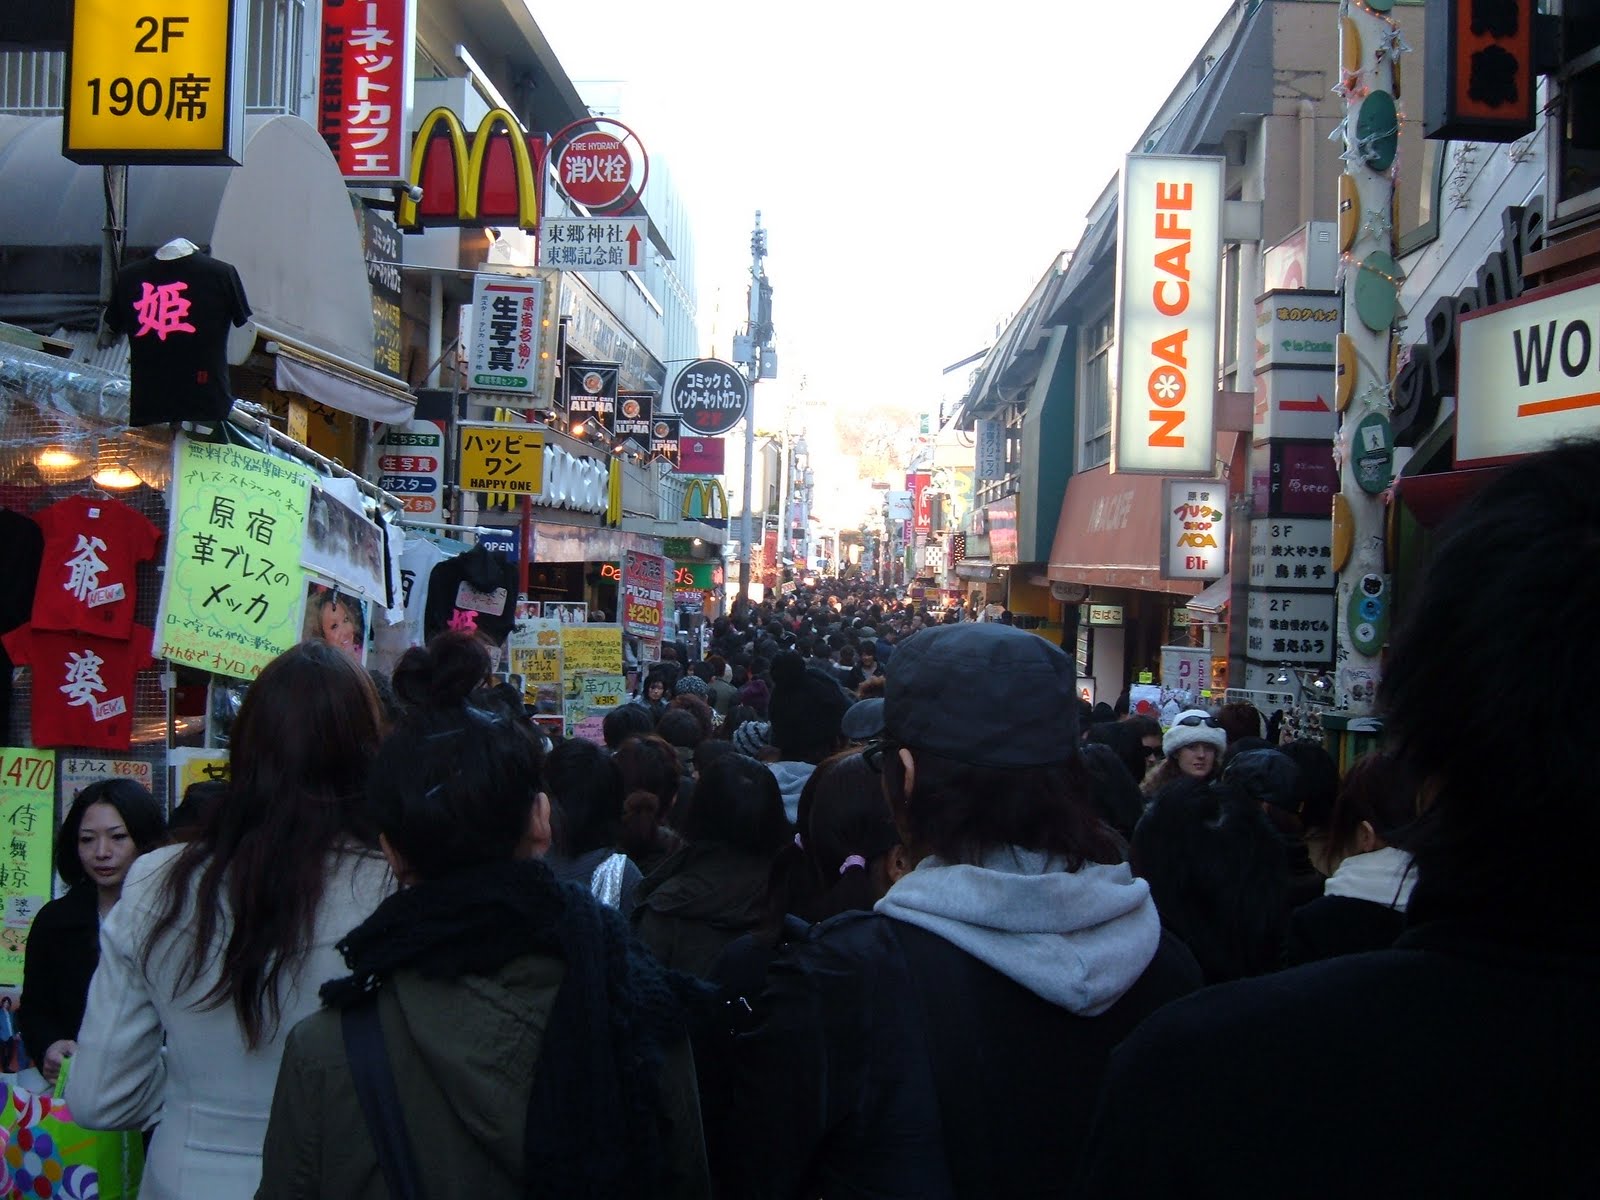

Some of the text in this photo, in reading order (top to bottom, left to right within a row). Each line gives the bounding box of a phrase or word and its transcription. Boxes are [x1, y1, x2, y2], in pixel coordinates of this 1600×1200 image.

[134, 16, 190, 53] 2F
[323, 24, 344, 163] NTERNET
[347, 0, 394, 171] ーネットカフェ
[87, 73, 211, 122] 190席
[571, 141, 620, 151] FIRE HYDRANT
[566, 154, 627, 184] 消火栓
[547, 224, 624, 244] 東郷神社
[547, 245, 624, 266] 東郷記念館
[1153, 182, 1192, 316] CAFE
[133, 281, 196, 341] 姫
[488, 295, 518, 372] 生写真
[1513, 318, 1600, 388] WO
[687, 373, 721, 389] コミック
[1148, 328, 1188, 448] NOA
[571, 401, 614, 413] ALPHA
[677, 390, 741, 409] インターネットカフェ
[391, 435, 436, 445] こちらです
[465, 435, 541, 455] ハッピー
[652, 443, 678, 452] LPHA
[383, 458, 431, 471] 生写真
[485, 458, 522, 476] ワン
[383, 478, 433, 491] ポスター
[470, 478, 532, 491] HAPPY ONE
[209, 496, 277, 546] 原宿
[1183, 522, 1212, 530] SHOP
[1272, 525, 1293, 537] 3F
[484, 542, 514, 552] OPEN
[192, 531, 290, 587] 革ブレスの
[202, 583, 269, 623] メッカ
[1270, 599, 1291, 612] 2F
[628, 603, 660, 624] ¥290
[1092, 610, 1121, 620] たばこ
[584, 679, 624, 694] 革ブレス
[8, 803, 37, 832] 侍
